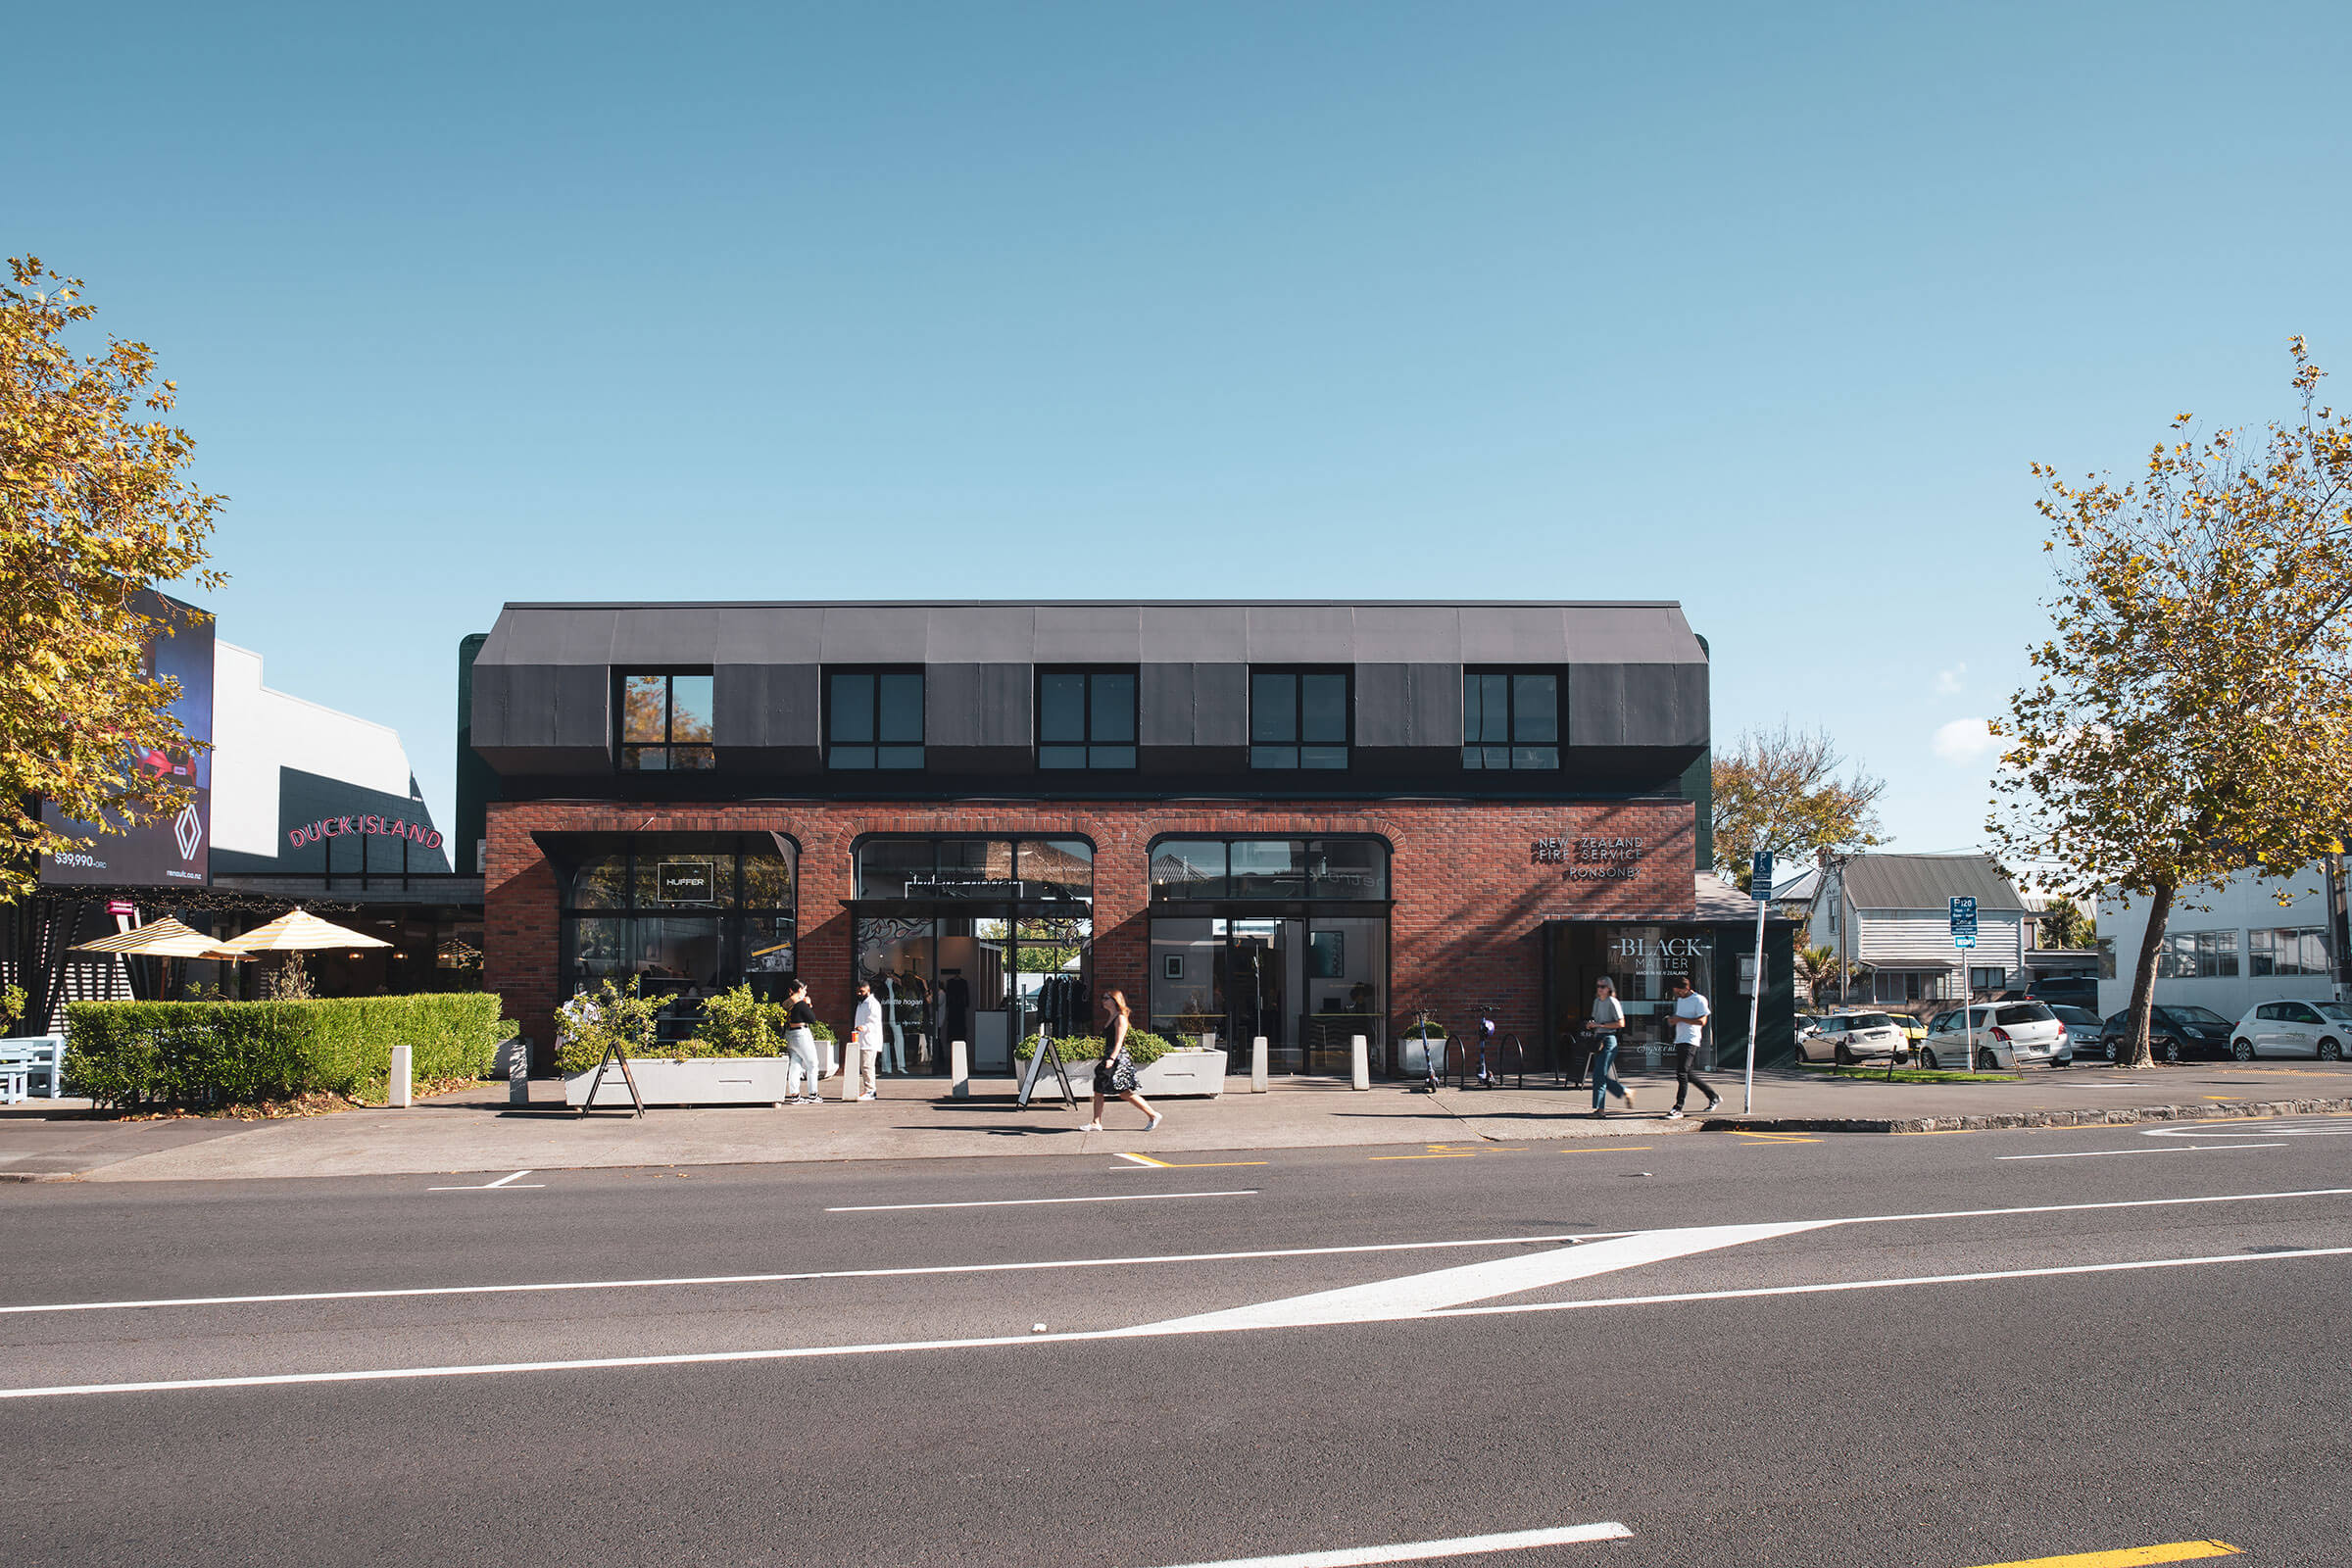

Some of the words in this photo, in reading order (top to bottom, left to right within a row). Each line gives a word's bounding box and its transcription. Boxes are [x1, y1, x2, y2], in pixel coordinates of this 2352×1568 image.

[289, 815, 355, 849] DUCK
[359, 814, 443, 850] ISLAND
[1539, 837, 1569, 848] NEW
[1581, 837, 1644, 848] ZEALAND
[1539, 849, 1570, 860] FIRE
[1582, 849, 1643, 860] SERVICE
[1569, 867, 1642, 878] PONSONBY
[1620, 938, 1703, 956] BLACK
[1636, 958, 1689, 969] MATTER
